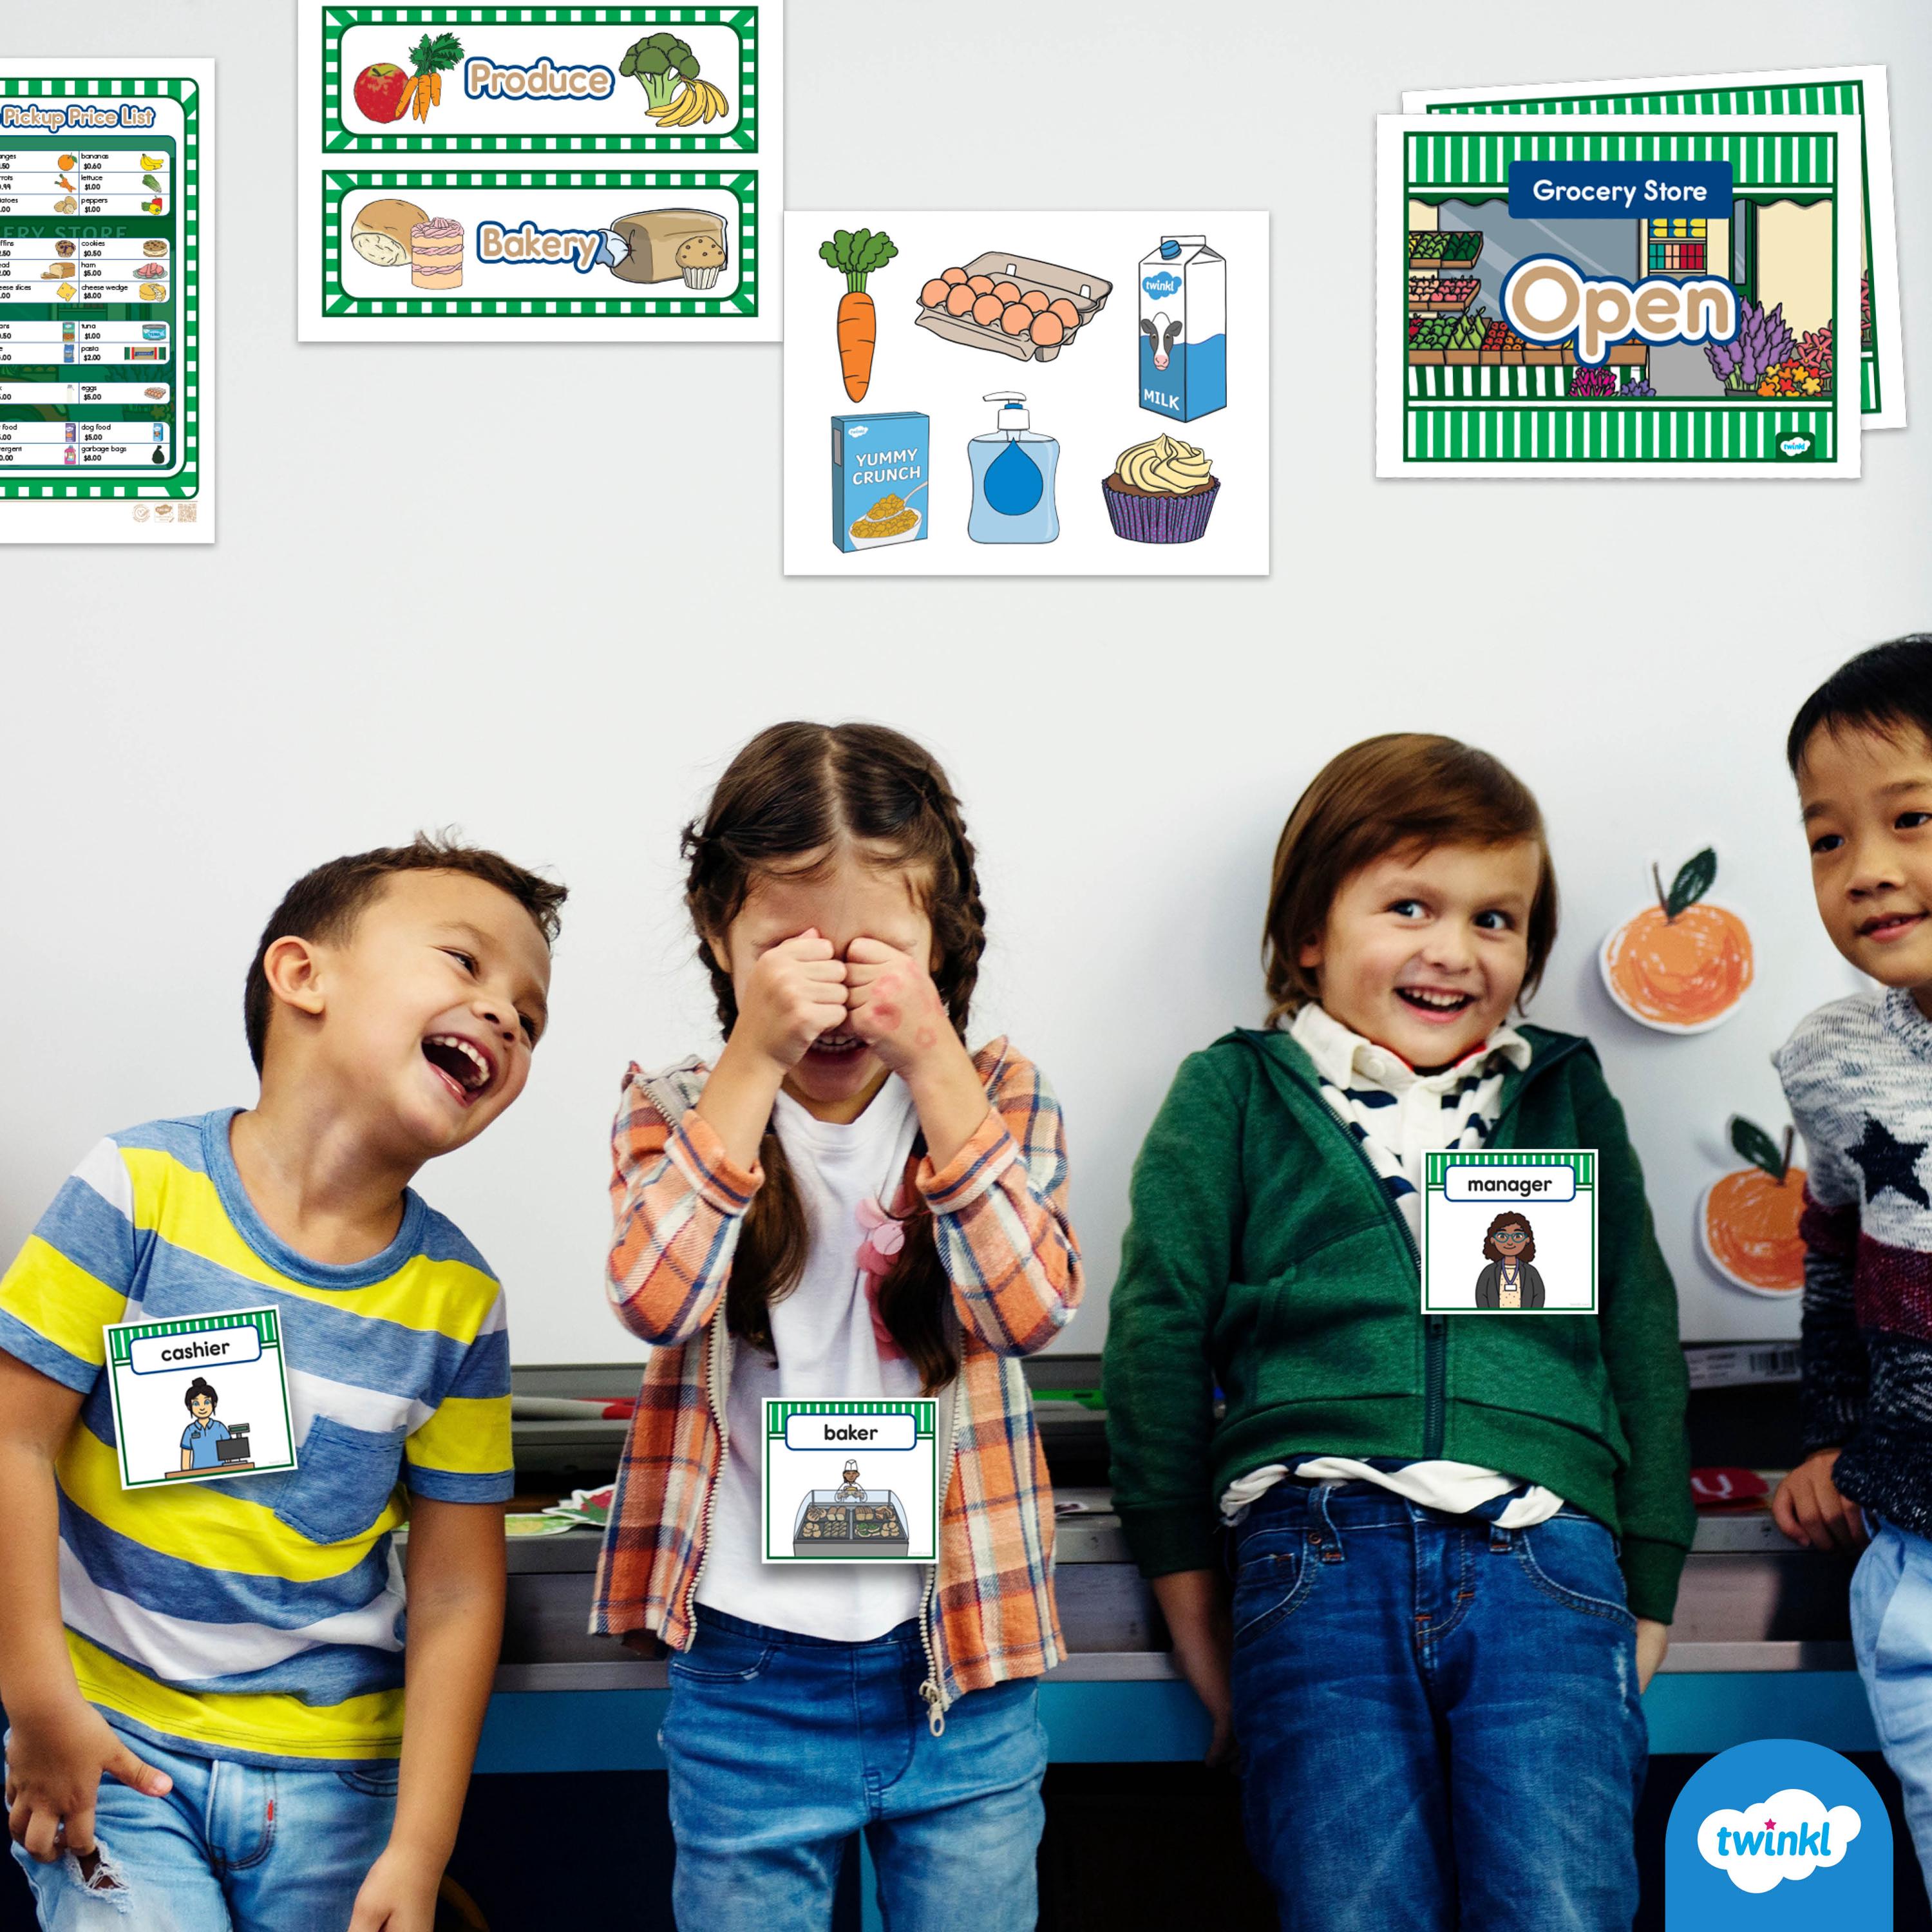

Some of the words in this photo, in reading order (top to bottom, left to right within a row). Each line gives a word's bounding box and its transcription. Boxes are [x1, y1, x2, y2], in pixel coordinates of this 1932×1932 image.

[469, 61, 611, 96] Produce
[4, 106, 64, 130] Pickup
[69, 106, 117, 125] Price
[122, 106, 153, 125] List
[1533, 180, 1637, 209] Grocery
[1643, 180, 1707, 201] Store
[482, 225, 598, 269] Bakery
[1145, 279, 1175, 292] twinkl
[1508, 261, 1732, 360] Open
[1143, 388, 1180, 410] MILK
[855, 447, 918, 468] YUMMY
[852, 465, 922, 486] CRUNCH
[1468, 1180, 1552, 1197] manager
[160, 1340, 231, 1362] cashier
[825, 1425, 878, 1440] baker
